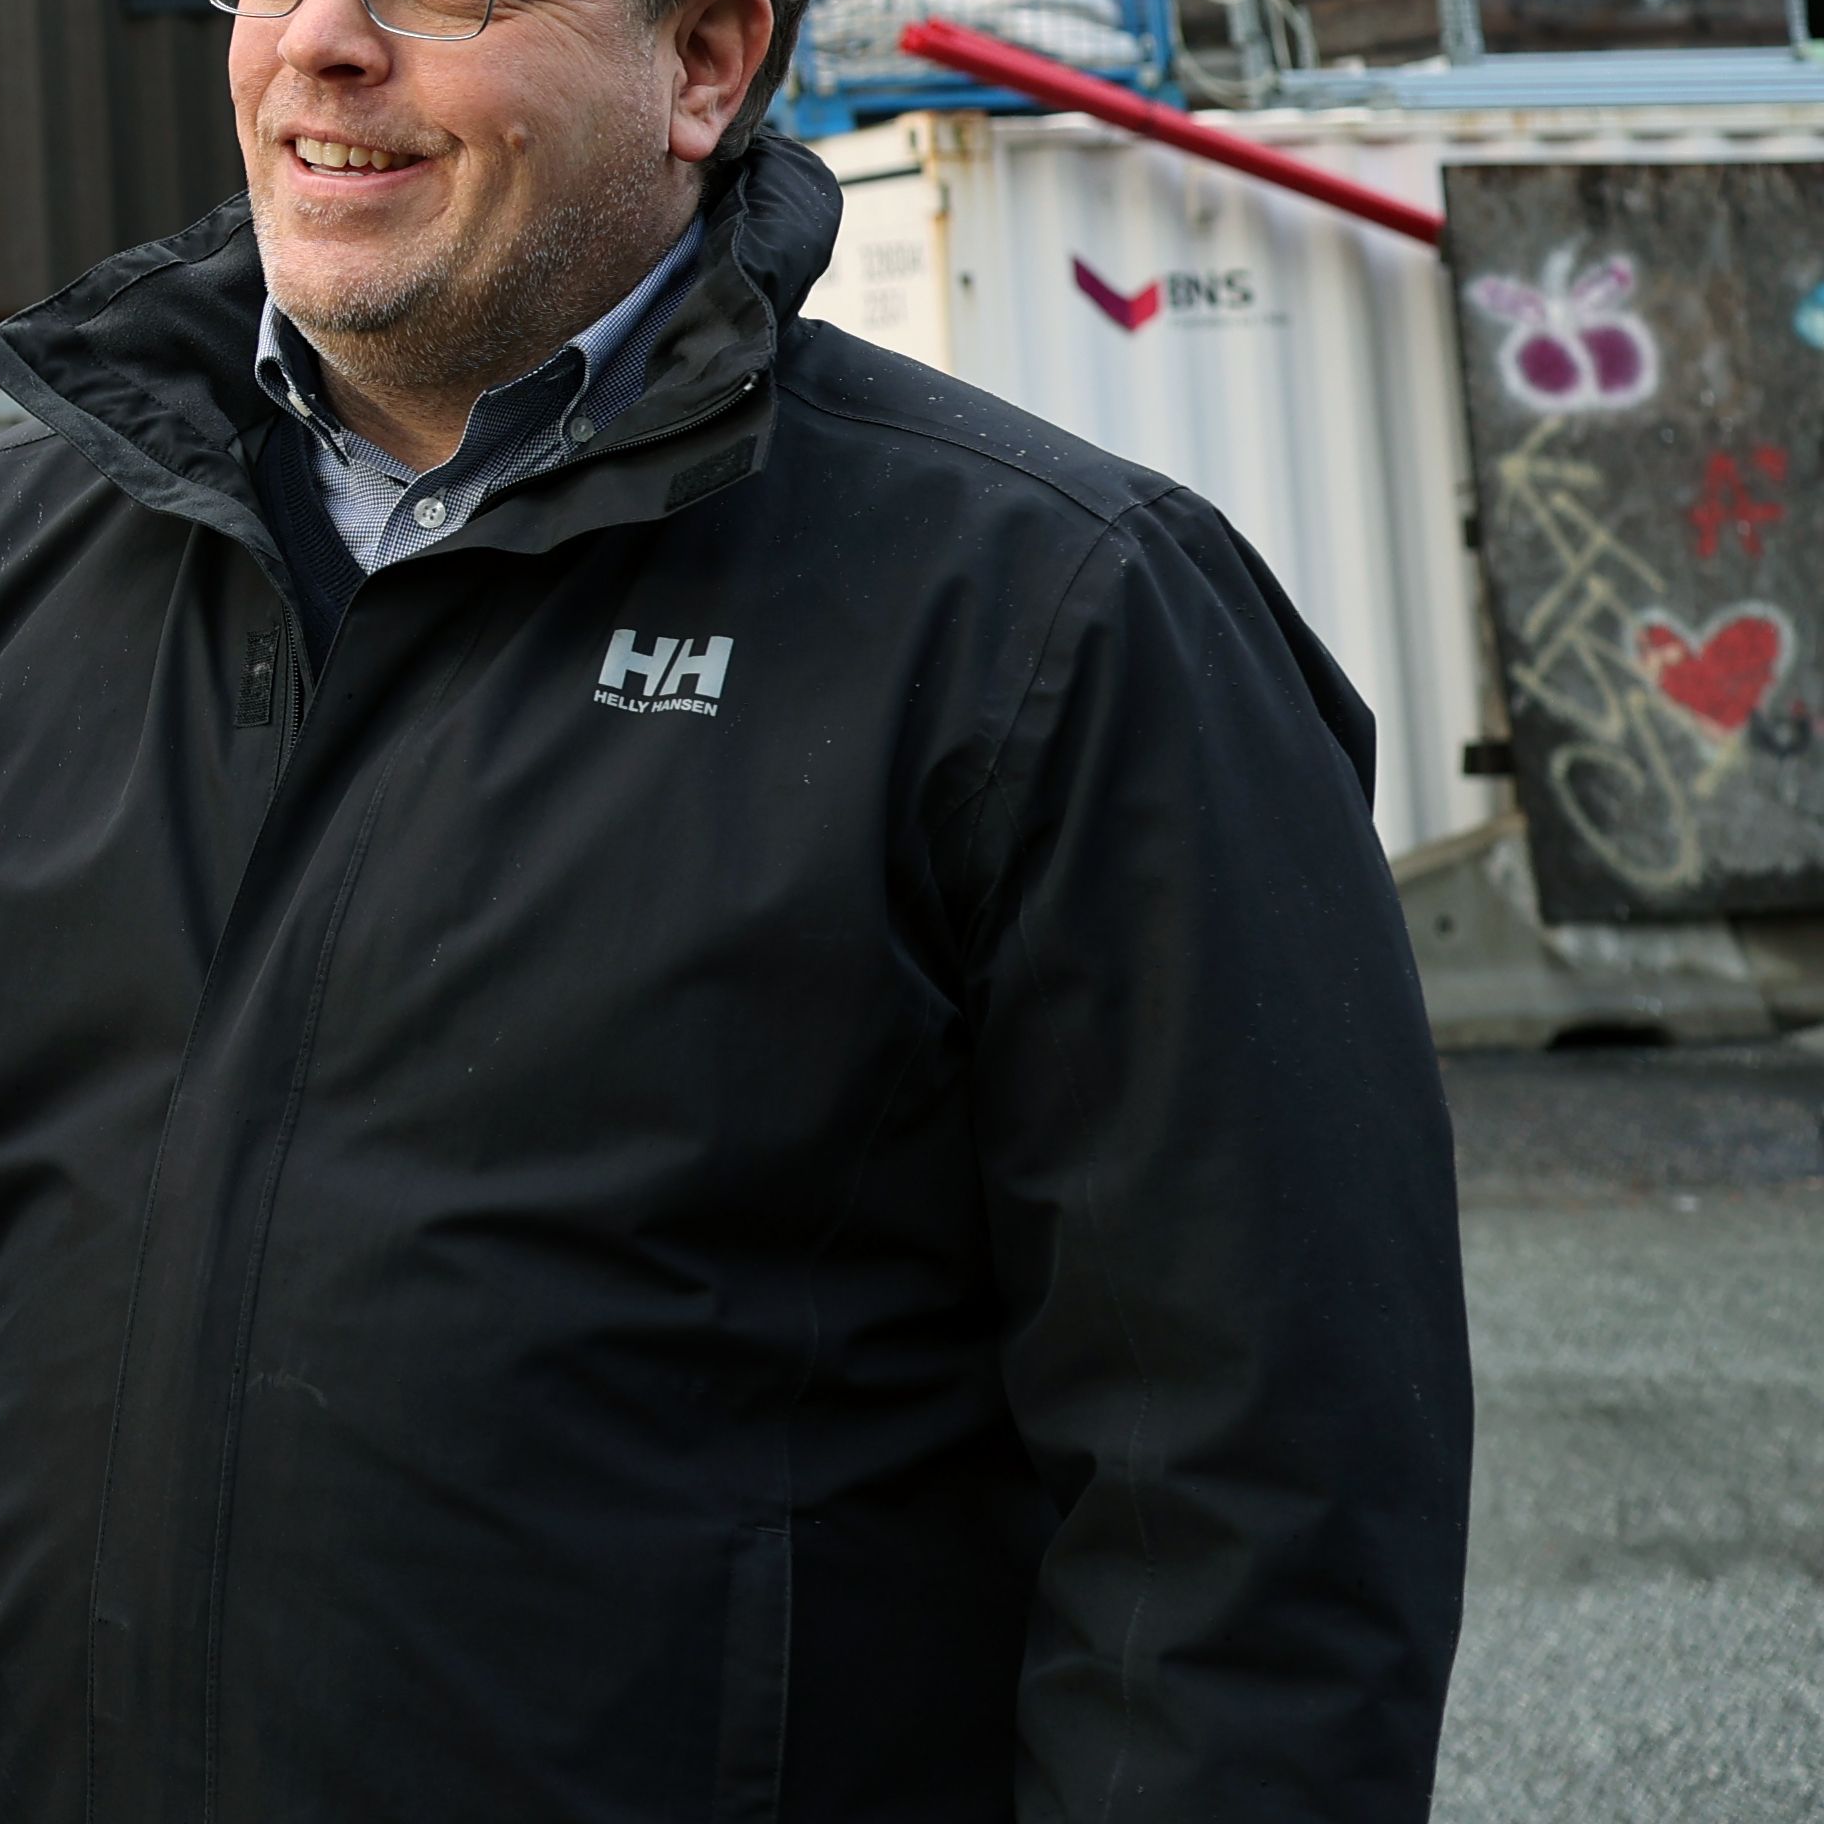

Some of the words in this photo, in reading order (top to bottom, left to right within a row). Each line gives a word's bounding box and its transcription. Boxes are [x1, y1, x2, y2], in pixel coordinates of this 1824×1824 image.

[599, 629, 734, 698] HH
[594, 690, 649, 713] HELLY
[651, 698, 718, 717] HANSEN
